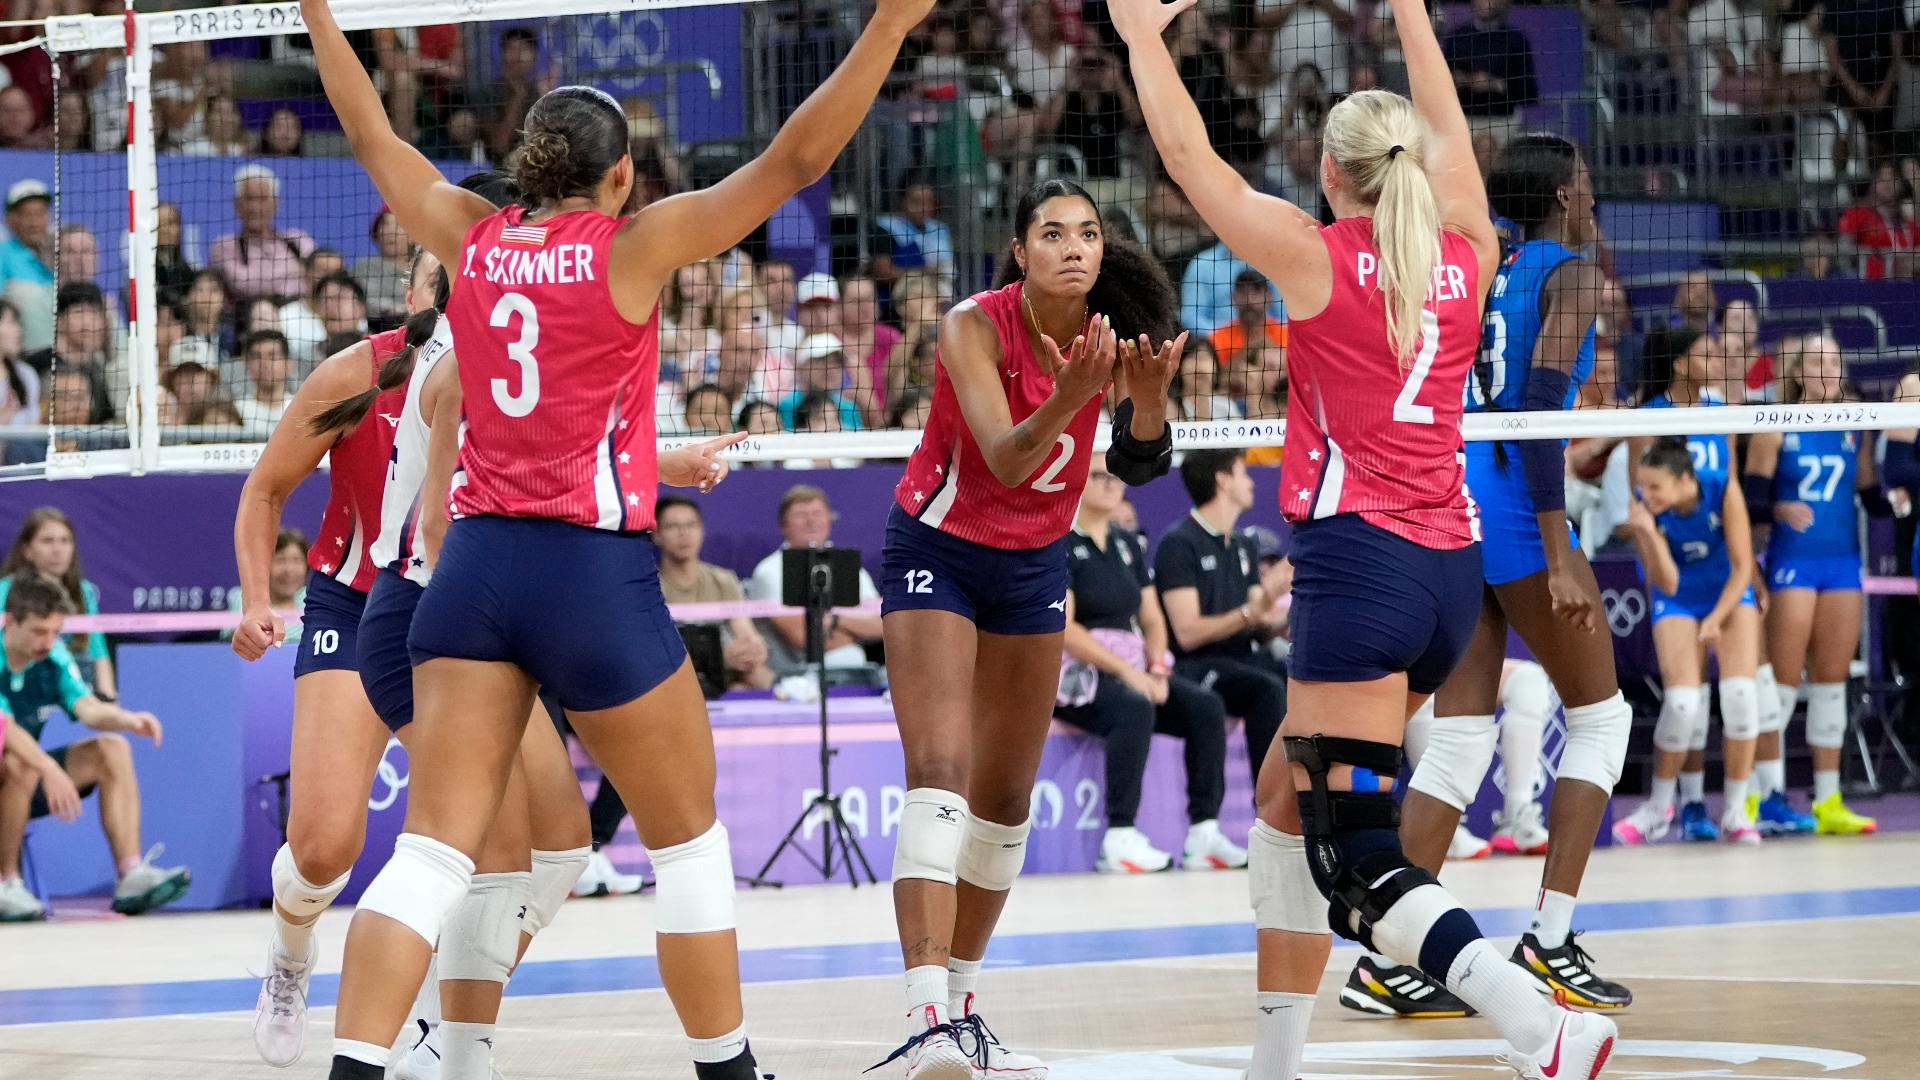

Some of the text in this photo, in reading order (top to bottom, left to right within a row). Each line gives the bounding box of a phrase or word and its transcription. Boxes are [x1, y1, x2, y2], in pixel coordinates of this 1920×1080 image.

[252, 6, 302, 29] 202
[484, 243, 595, 285] SKINNER
[489, 292, 541, 418] 3
[1392, 308, 1440, 424] 2
[1030, 432, 1076, 493] 2
[1797, 455, 1846, 502] 27
[903, 569, 934, 594] 12
[312, 629, 339, 656] 10
